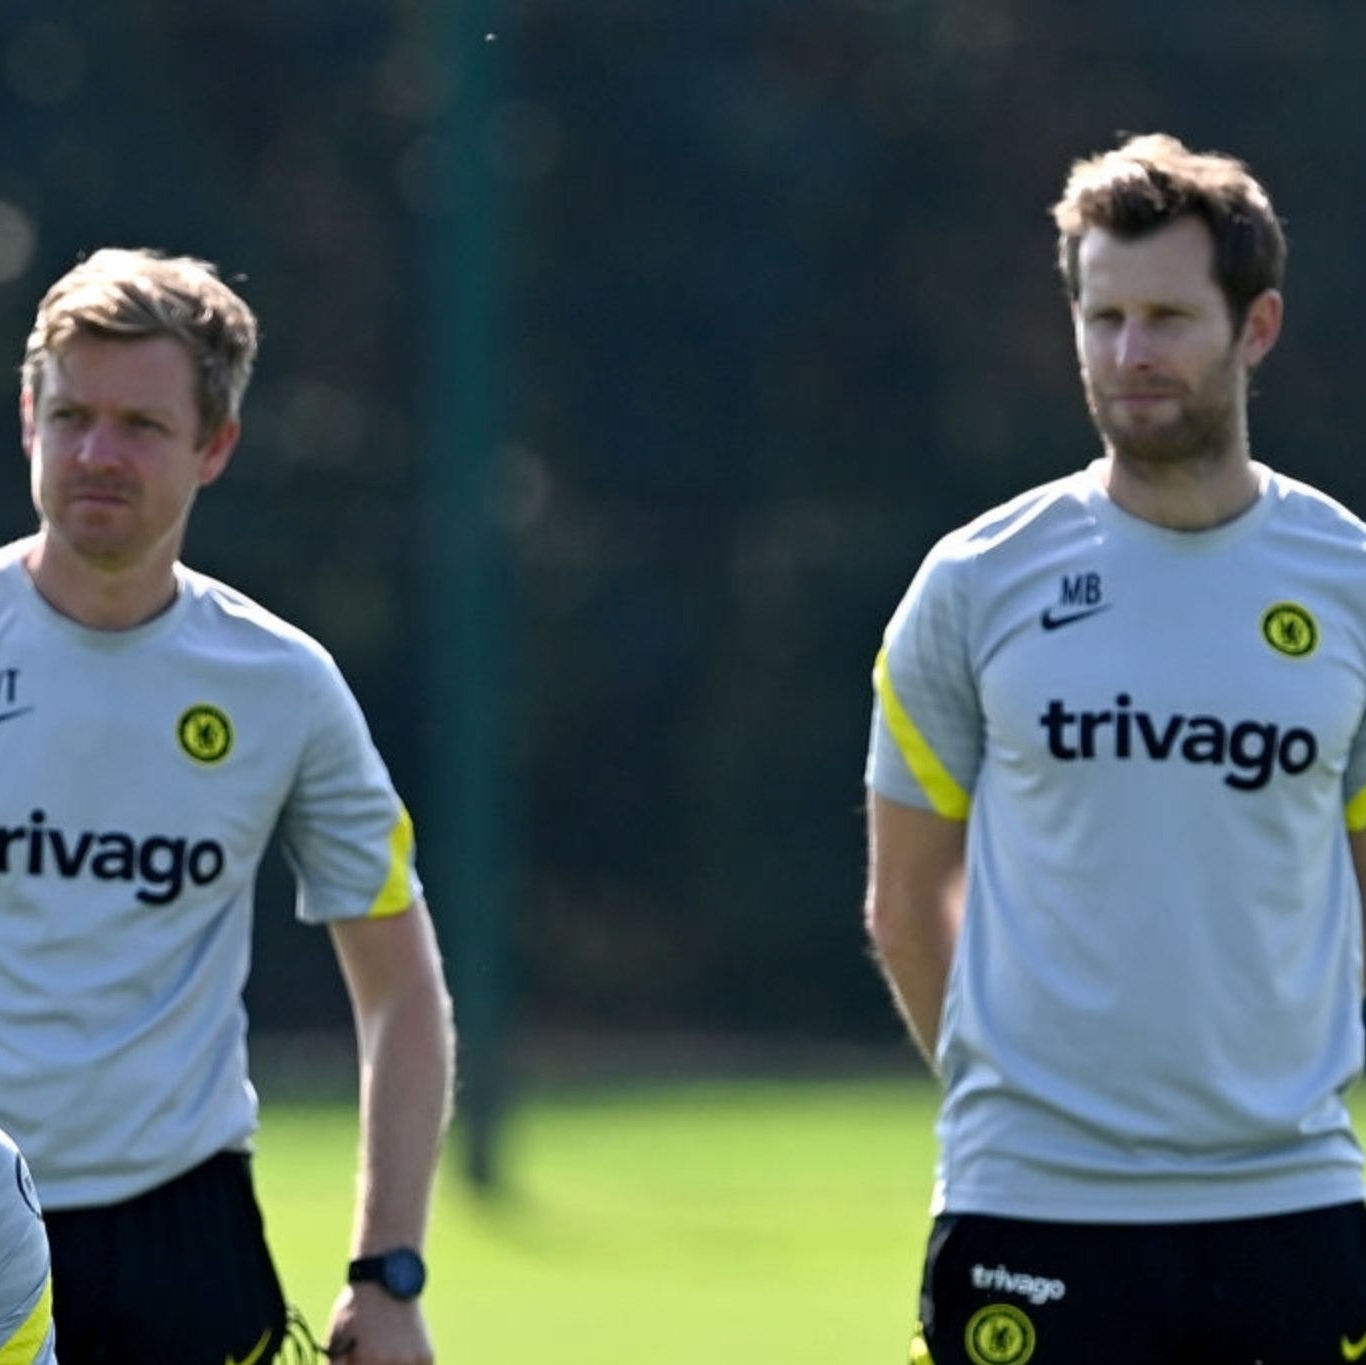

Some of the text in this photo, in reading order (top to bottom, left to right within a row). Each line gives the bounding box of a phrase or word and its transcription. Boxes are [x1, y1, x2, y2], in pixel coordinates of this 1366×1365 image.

[1059, 571, 1102, 605] MB
[1040, 693, 1318, 791] trivago
[969, 1262, 1067, 1305] trivago
